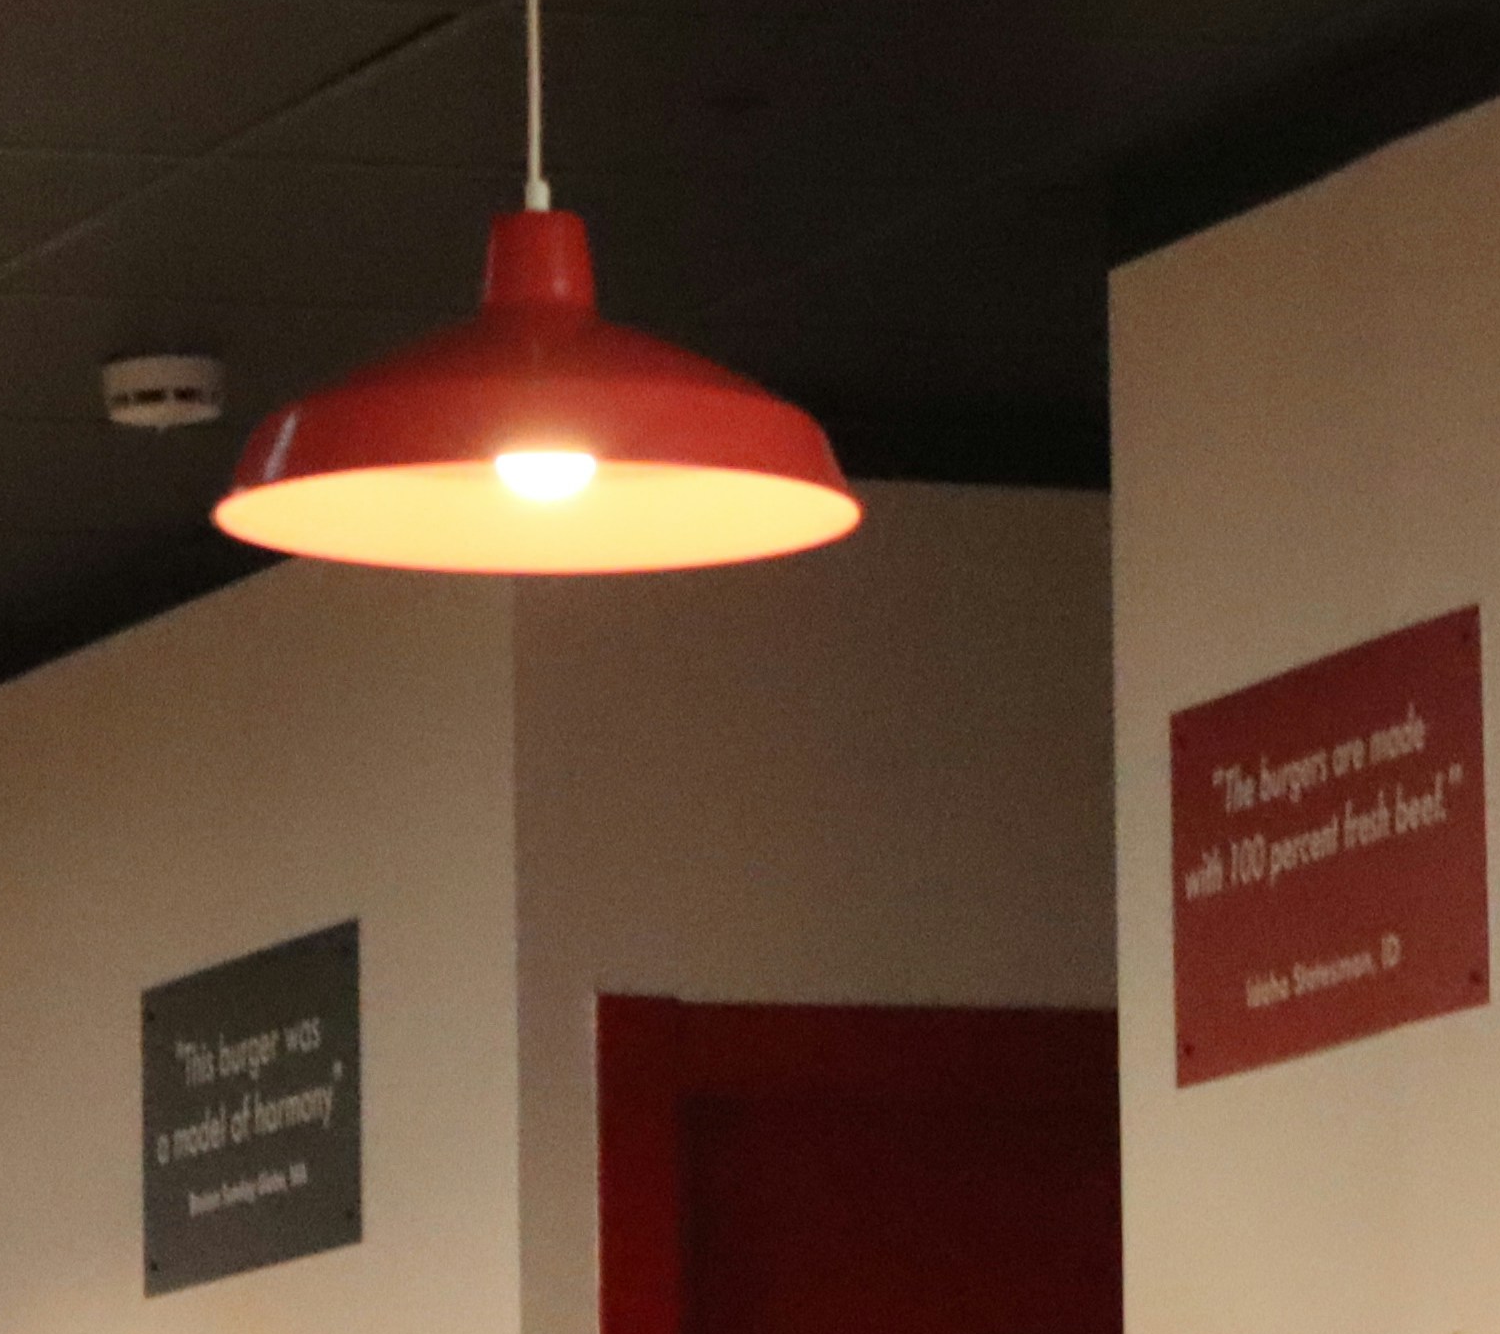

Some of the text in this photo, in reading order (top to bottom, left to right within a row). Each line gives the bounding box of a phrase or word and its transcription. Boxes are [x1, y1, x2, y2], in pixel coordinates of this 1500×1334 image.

[1259, 754, 1327, 803] burgers
[1333, 740, 1365, 775] are
[1370, 702, 1426, 762] made
[1185, 844, 1224, 901] with
[1230, 831, 1266, 887] 100
[1270, 814, 1338, 887] percent
[1344, 790, 1391, 851] fresh
[1381, 932, 1400, 968] ID
[219, 1031, 280, 1082] burger
[284, 1017, 321, 1054] was
[156, 1133, 169, 1165] a
[172, 1102, 227, 1160] model
[230, 1093, 251, 1144] of
